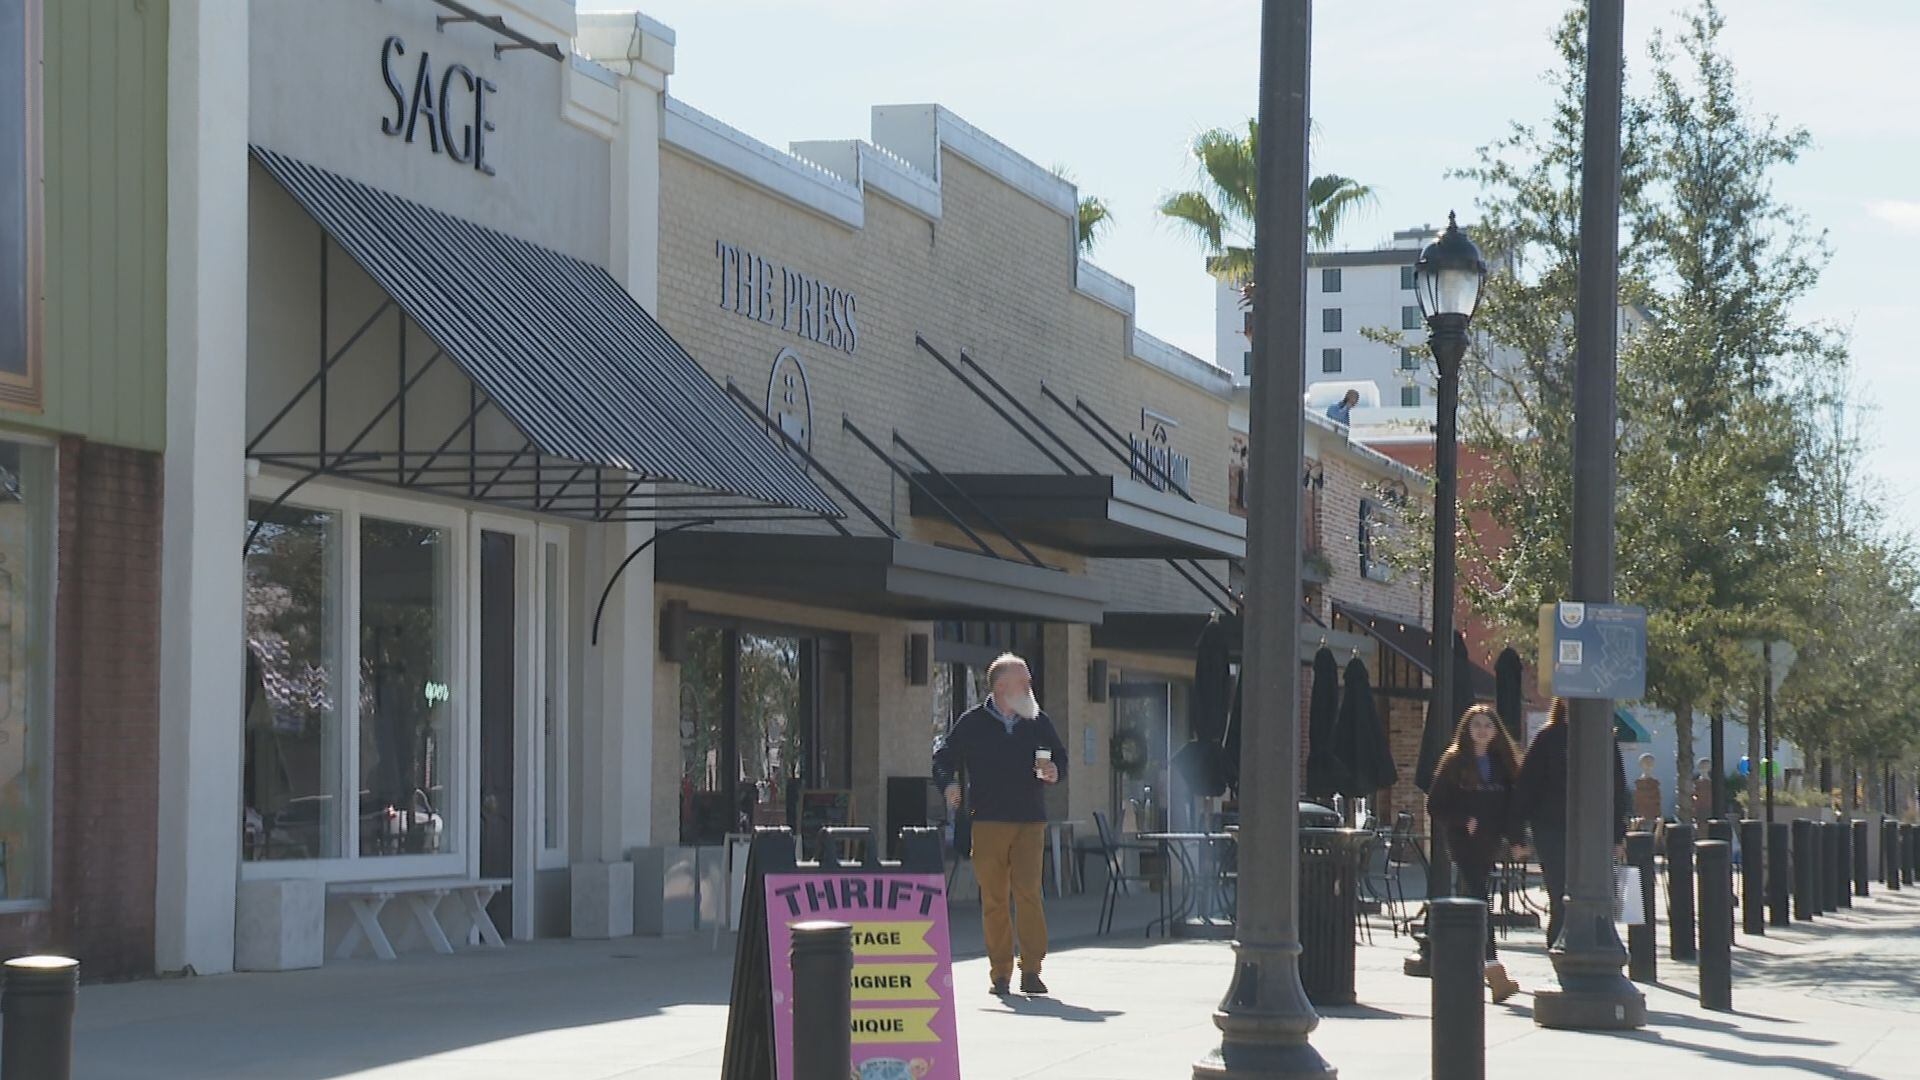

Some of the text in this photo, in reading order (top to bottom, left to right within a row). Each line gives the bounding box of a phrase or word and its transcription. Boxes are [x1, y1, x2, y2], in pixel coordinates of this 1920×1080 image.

[381, 36, 497, 176] SAGE
[716, 239, 859, 355] THE PRESS
[775, 877, 942, 917] THRIFT
[853, 931, 901, 945] TAGE
[850, 975, 912, 988] IGNER
[850, 1019, 904, 1034] NIQUE
